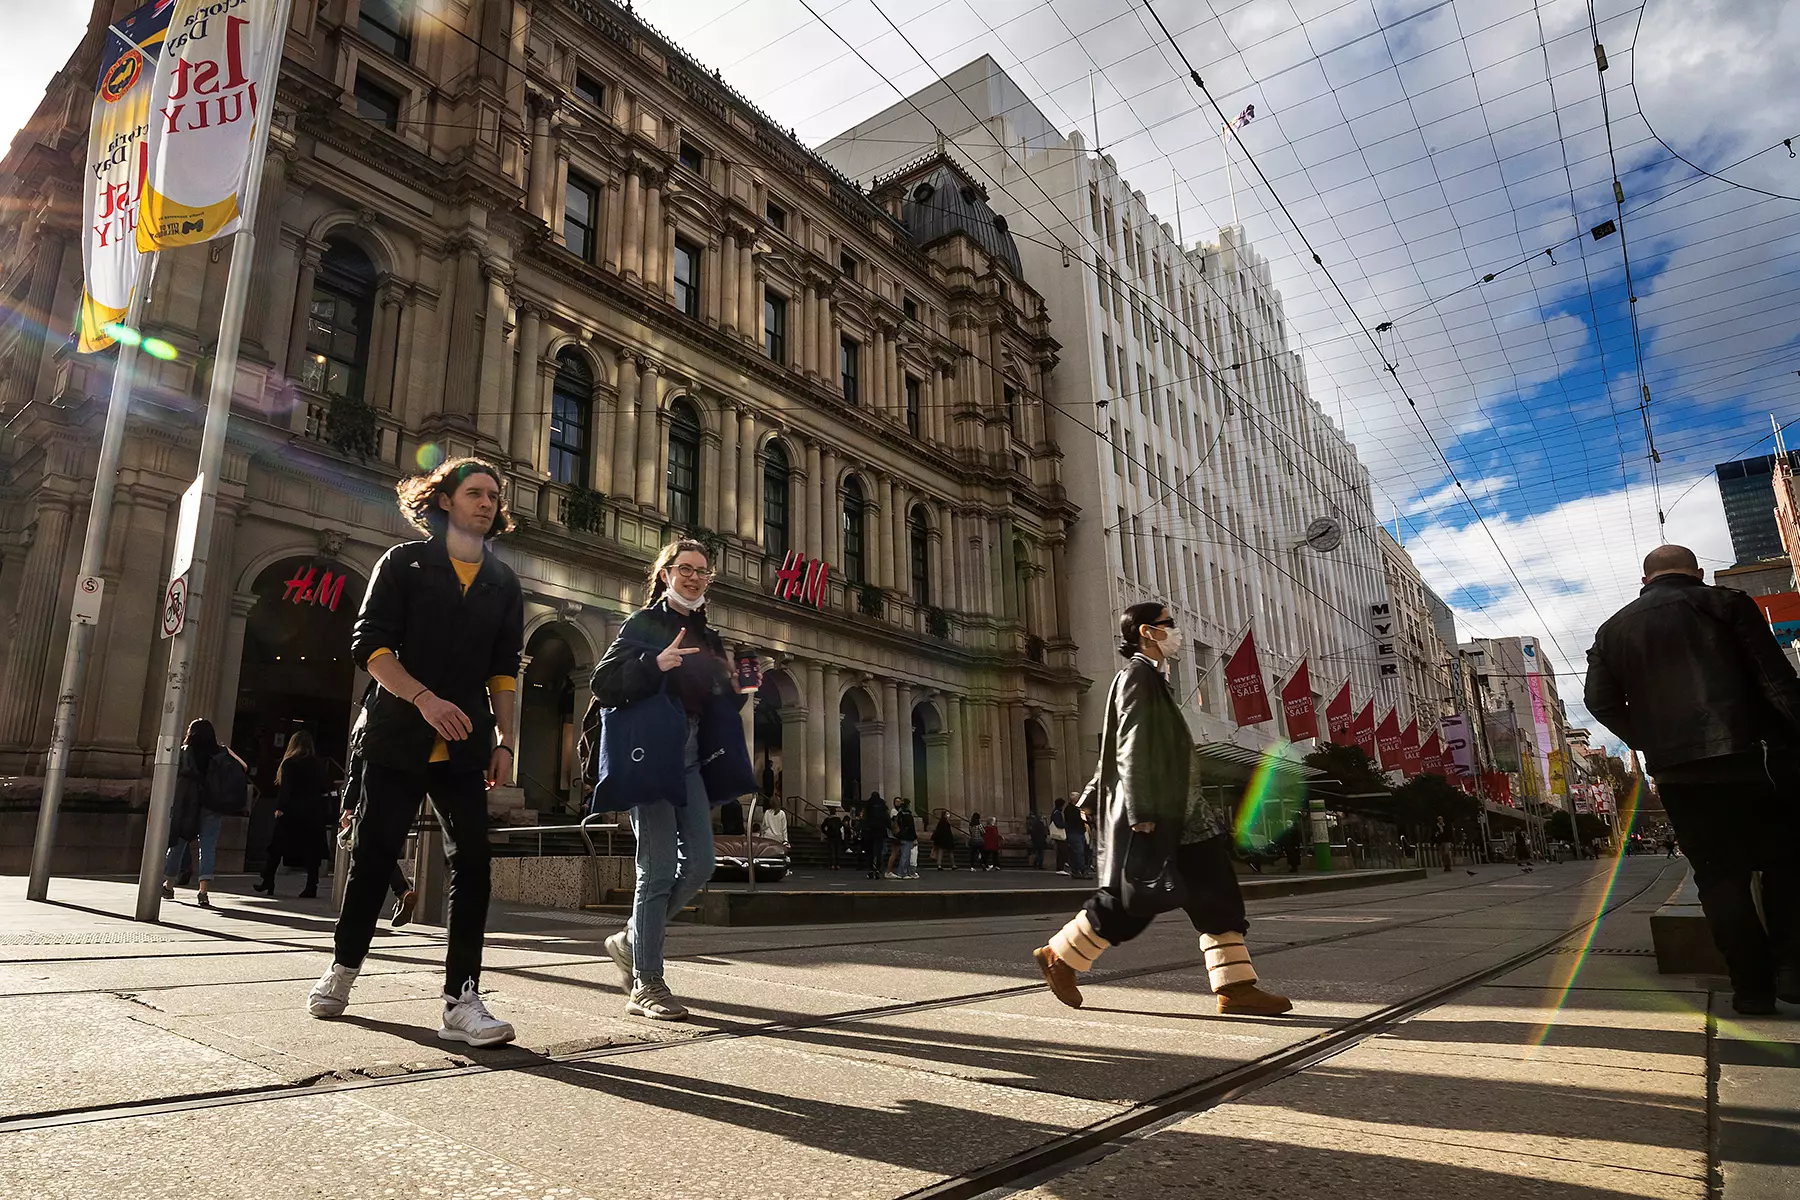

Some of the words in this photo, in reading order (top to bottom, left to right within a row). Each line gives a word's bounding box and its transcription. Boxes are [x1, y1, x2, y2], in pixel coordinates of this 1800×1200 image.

[774, 549, 829, 610] H&M
[85, 580, 95, 591] S
[282, 565, 346, 612] H&M
[1372, 603, 1397, 676] MYER
[1233, 673, 1257, 684] MYER
[1237, 684, 1260, 697] SALE
[1288, 696, 1308, 706] MYER
[1289, 705, 1310, 717] SALE
[1357, 735, 1373, 745] SALE
[1381, 742, 1400, 752] SALE
